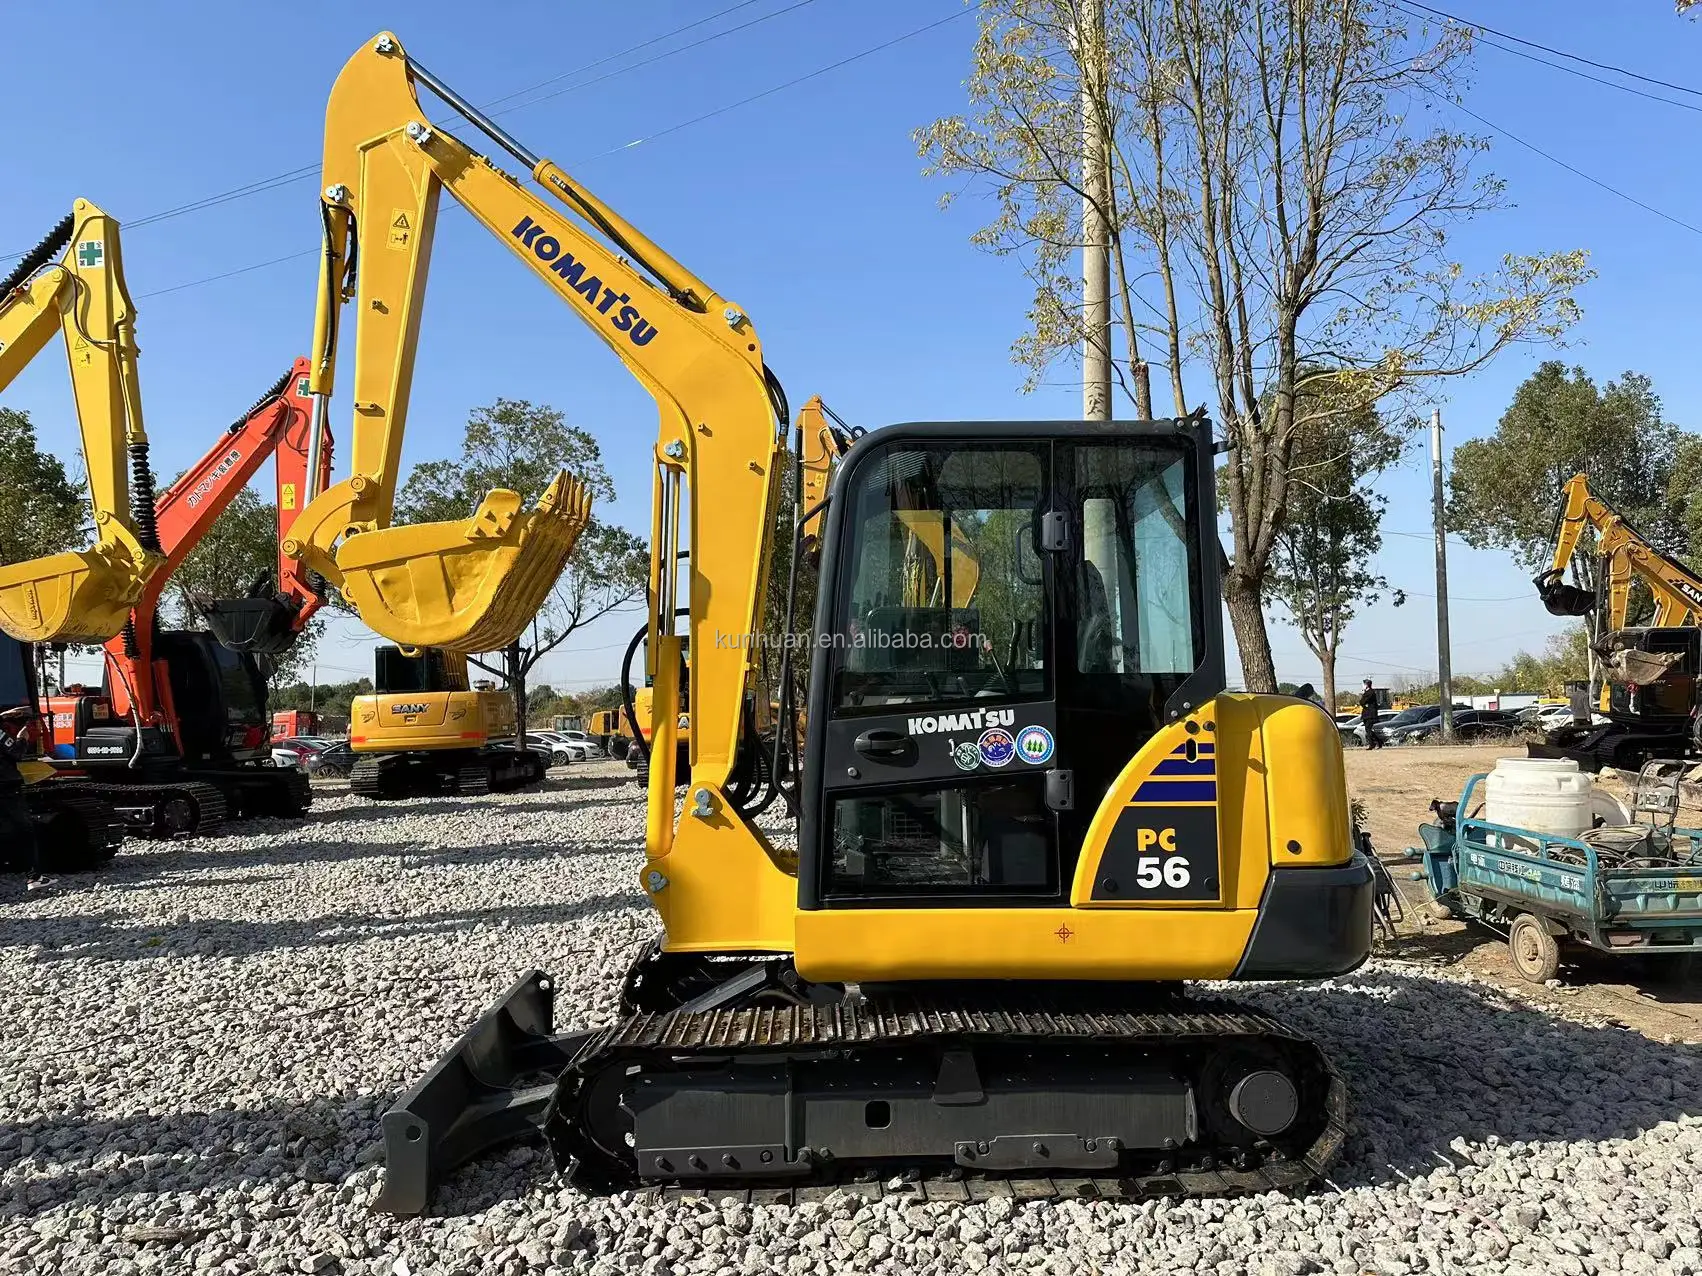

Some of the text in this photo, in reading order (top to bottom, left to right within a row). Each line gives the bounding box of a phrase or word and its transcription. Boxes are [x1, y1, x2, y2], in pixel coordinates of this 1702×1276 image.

[511, 215, 659, 347] KOMATSU
[391, 703, 431, 714] SANY
[908, 708, 1015, 735] KOMATSU
[1137, 828, 1177, 852] PC
[1136, 856, 1191, 889] 56
